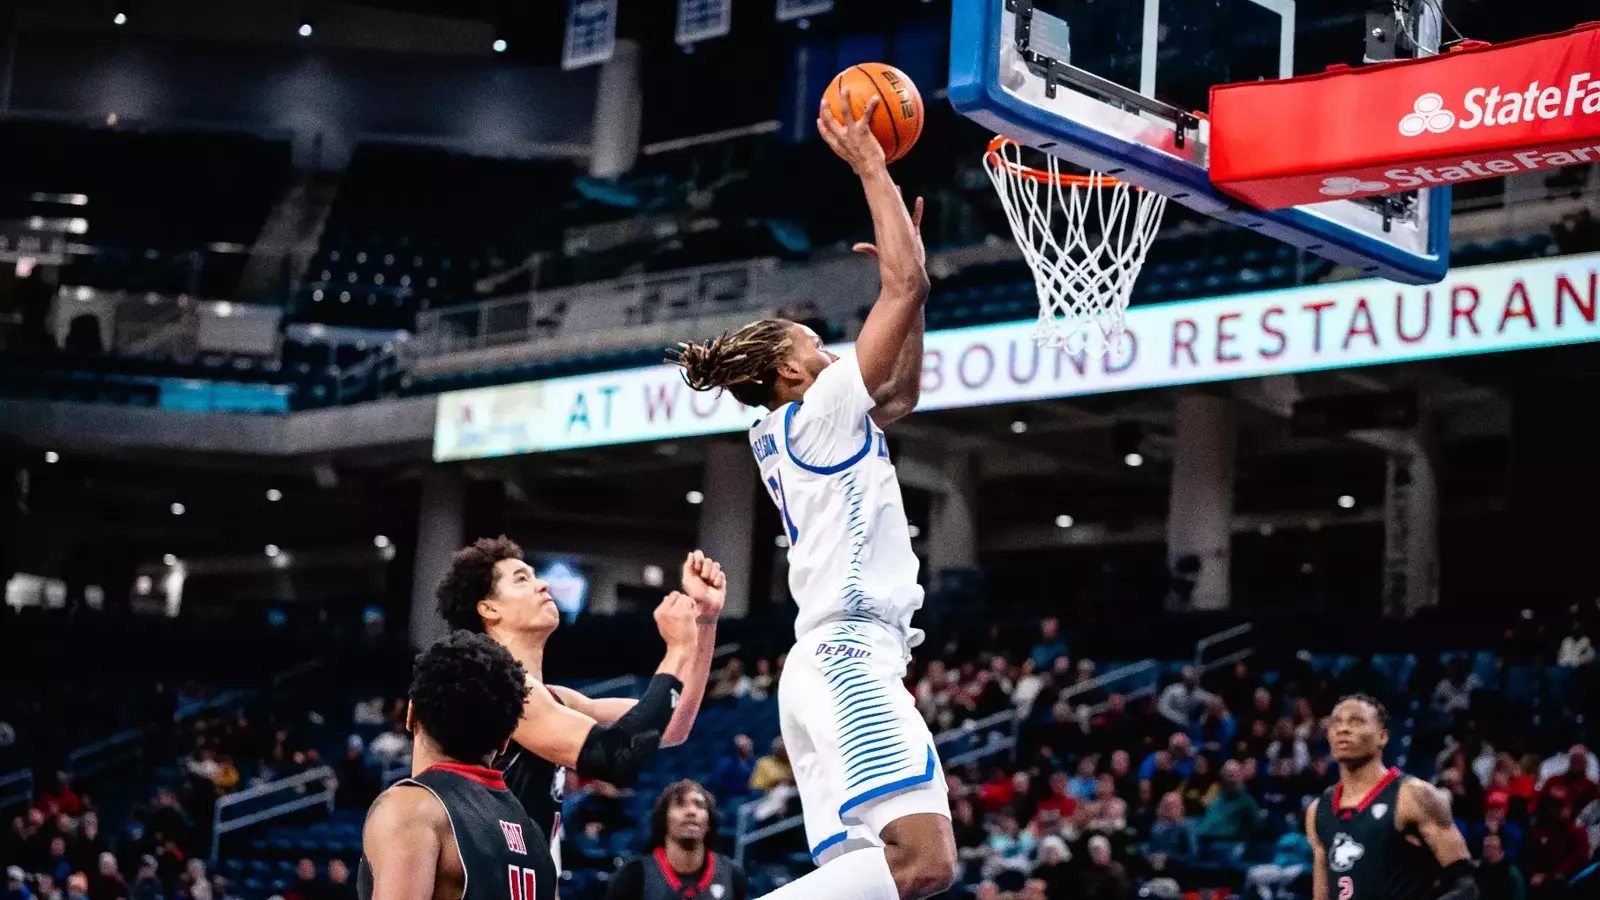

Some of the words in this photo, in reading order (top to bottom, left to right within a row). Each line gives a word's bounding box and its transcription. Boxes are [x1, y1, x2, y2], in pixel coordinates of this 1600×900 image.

[1459, 79, 1561, 129] State
[1385, 158, 1519, 187] State
[1512, 146, 1600, 169] Far
[566, 385, 621, 433] AT
[643, 377, 748, 423] WO
[1168, 270, 1599, 368] RESTAURAN
